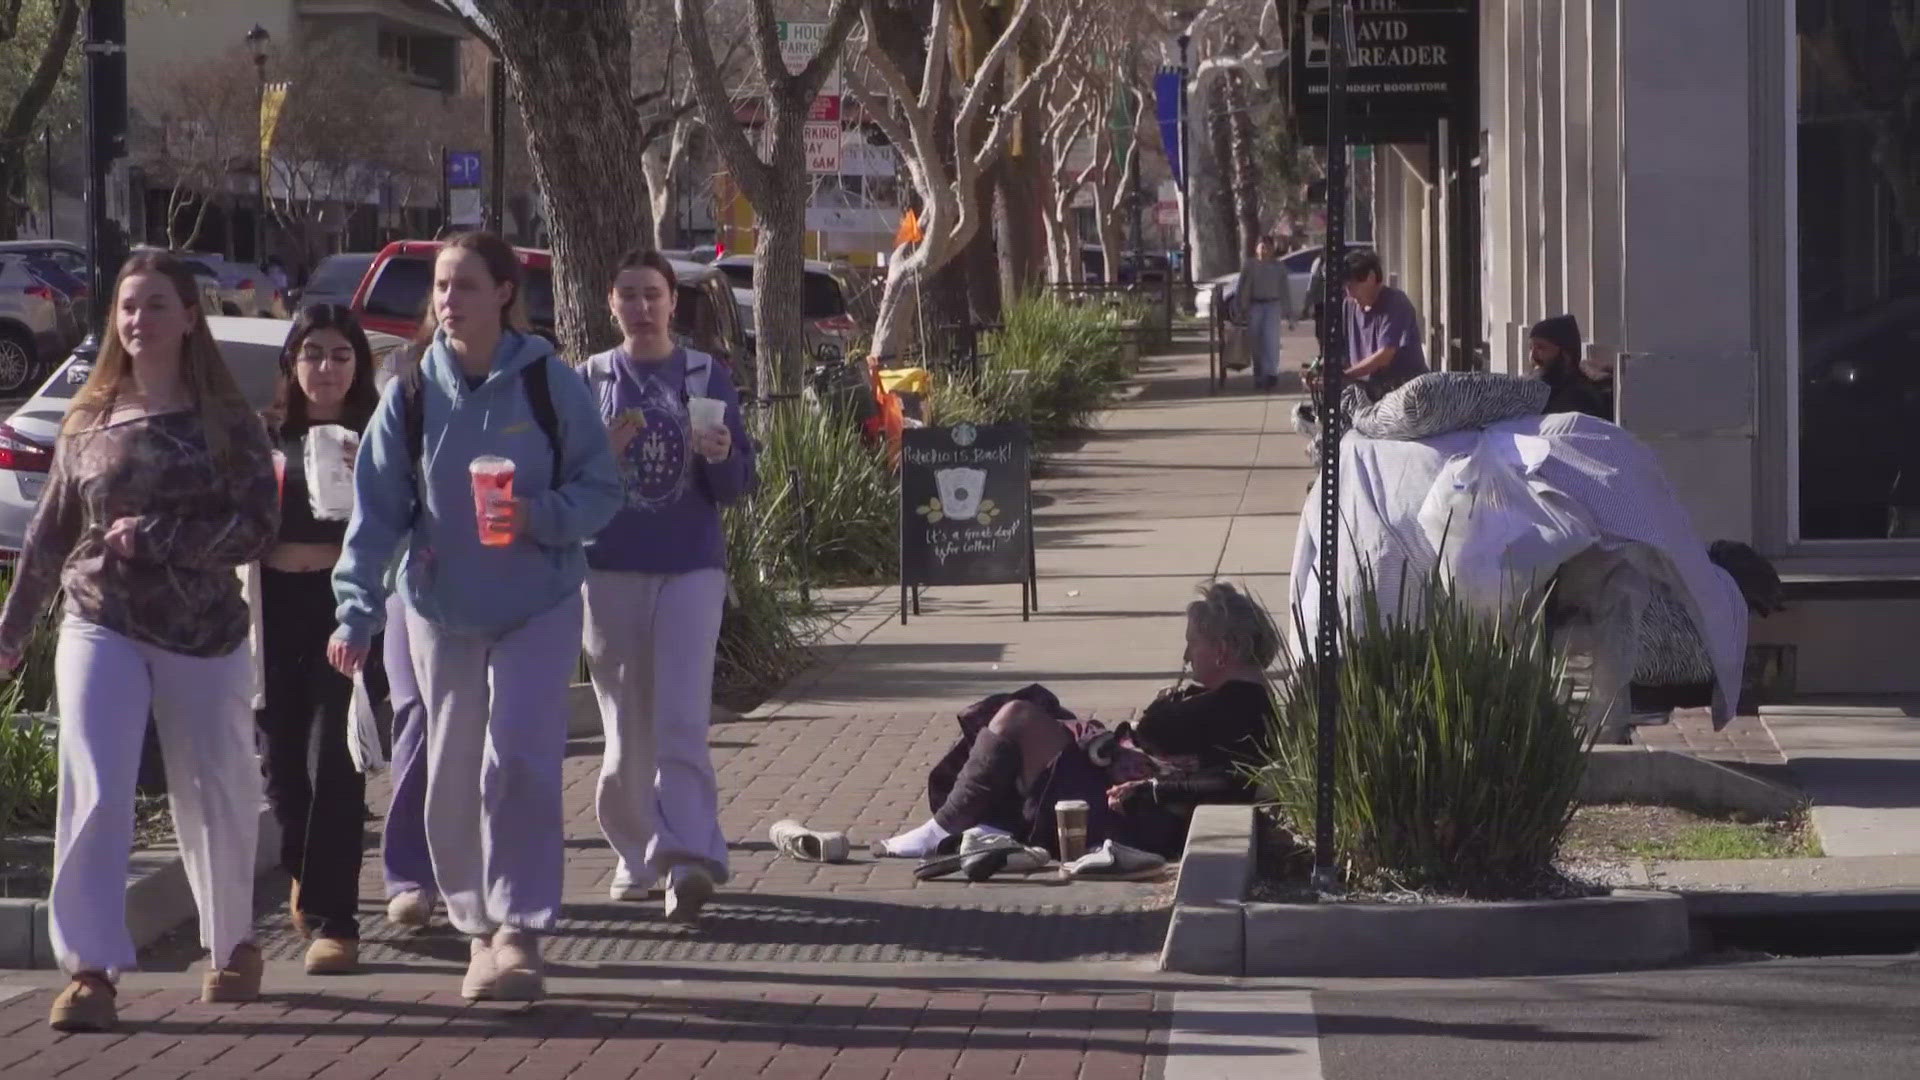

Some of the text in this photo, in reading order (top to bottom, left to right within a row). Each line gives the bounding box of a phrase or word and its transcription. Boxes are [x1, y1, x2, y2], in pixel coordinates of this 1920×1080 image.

[794, 25, 825, 40] HOU
[1357, 20, 1408, 41] AVID
[1357, 45, 1448, 67] READER
[1308, 82, 1448, 95] INDNDENT BOOKSTORE
[804, 127, 837, 140] RKING
[464, 156, 480, 179] P
[812, 157, 836, 169] 6AM
[952, 530, 960, 541] a
